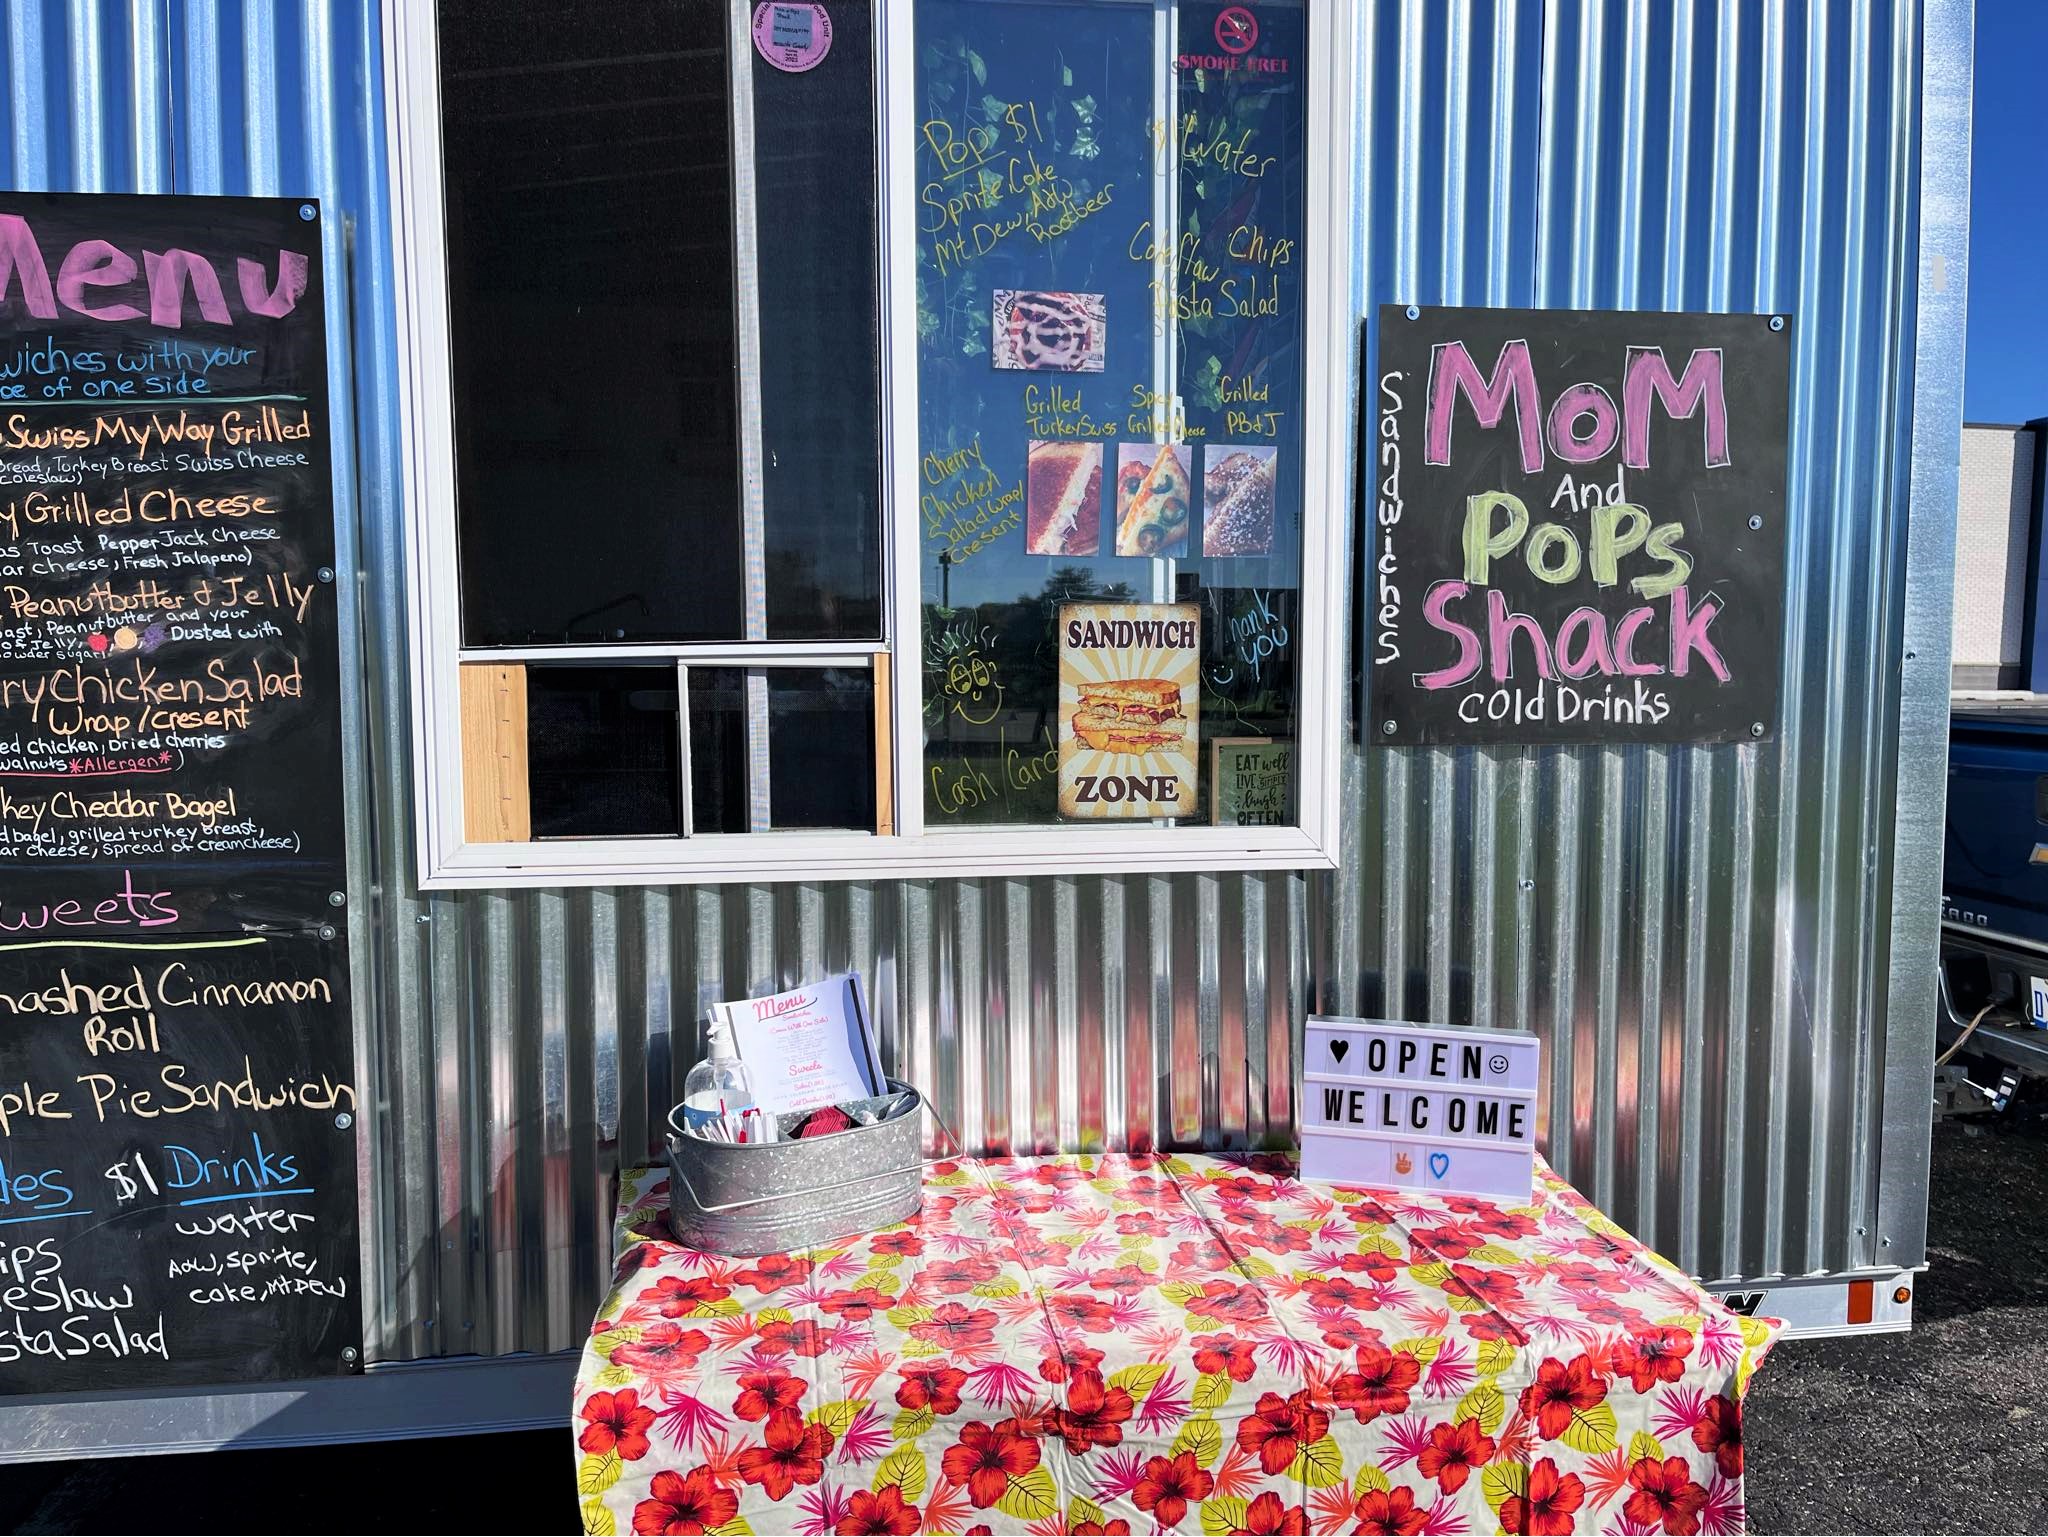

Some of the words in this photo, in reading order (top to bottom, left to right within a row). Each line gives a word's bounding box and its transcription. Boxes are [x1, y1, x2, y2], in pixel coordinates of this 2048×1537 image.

[1005, 101, 1043, 143] $1
[1228, 225, 1296, 268] Chips
[1219, 274, 1279, 318] Salad
[117, 341, 193, 372] with
[200, 346, 257, 374] your
[43, 376, 72, 398] of
[83, 379, 138, 397] one
[1026, 384, 1082, 414] Grilled
[1221, 375, 1269, 403] Grilled
[5, 414, 90, 449] Swiss
[94, 417, 151, 460] My
[152, 410, 215, 459] Way
[221, 405, 311, 445] Grilled
[52, 454, 107, 480] Turkey
[111, 452, 169, 473] Breast
[176, 453, 234, 472] Swiss
[237, 449, 310, 468] Cheese
[923, 440, 985, 486] Cherry
[921, 471, 1002, 525] Chicken
[1550, 463, 1626, 514] And
[25, 487, 133, 527] Grilled
[140, 487, 277, 522] Cheese
[1374, 371, 1403, 665] Sandwiches
[27, 534, 85, 556] Toast
[927, 505, 990, 554] Salad
[0, 565, 24, 577] ar
[123, 552, 169, 570] Fresh
[222, 572, 314, 624] Jelly
[166, 608, 200, 622] and
[209, 608, 250, 625] your
[171, 625, 232, 642] Dusted
[237, 621, 283, 640] with
[1067, 619, 1196, 650] SANDWICH
[1412, 579, 1732, 690] Shack
[0, 648, 50, 661] owder
[49, 657, 204, 704] Chicken
[206, 656, 303, 702] Salad
[1557, 678, 1671, 725] Drinks
[49, 706, 131, 738] Wrap
[109, 735, 161, 752] Dried
[1235, 754, 1260, 771] EAT
[1262, 752, 1290, 771] well
[1074, 775, 1180, 803] ZONE
[1236, 773, 1257, 790] LIVE
[50, 789, 160, 819] Cheddar
[166, 788, 237, 828] Bagel
[1236, 811, 1284, 827] OFTEN
[68, 826, 125, 848] grilled
[129, 825, 198, 846] turkey
[171, 837, 196, 853] of
[158, 962, 332, 1007] Cinnamon
[752, 994, 807, 1020] Menu
[2034, 990, 2048, 1018] D
[84, 1012, 160, 1056] Roll
[789, 1060, 823, 1076] Sweets
[1368, 1038, 1482, 1080] OPEN
[77, 1074, 160, 1122] Pie
[160, 1054, 357, 1116] Sandwich
[1324, 1088, 1526, 1138] WELCOME
[104, 1152, 159, 1205] $1
[164, 1132, 299, 1189] Drinks
